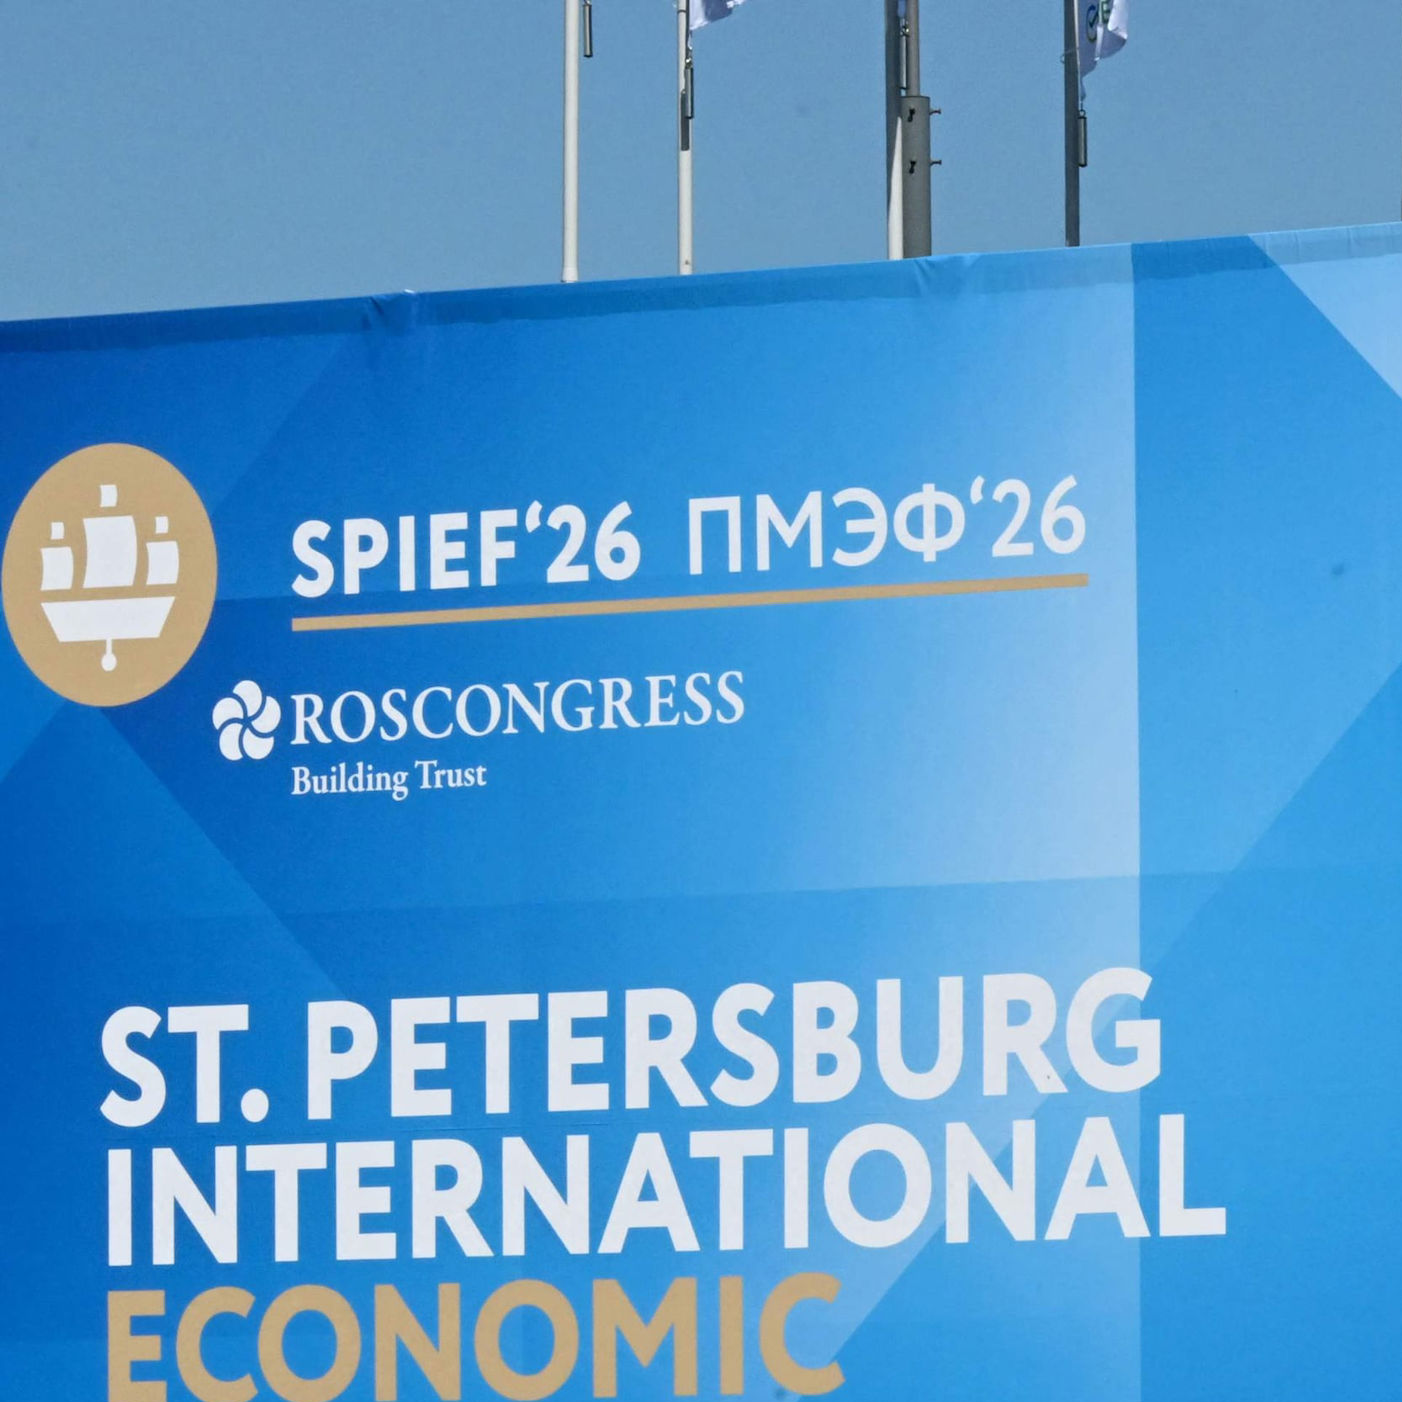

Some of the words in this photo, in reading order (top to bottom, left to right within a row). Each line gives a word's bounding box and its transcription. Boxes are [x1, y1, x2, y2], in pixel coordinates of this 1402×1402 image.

[290, 670, 746, 748] ROSCONGRESS
[291, 763, 409, 803] Building
[414, 758, 488, 792] Trust
[99, 1003, 270, 1127] ST.
[306, 965, 1162, 1121] PETERSBURG
[107, 1113, 1227, 1267] INTERNATIONAL
